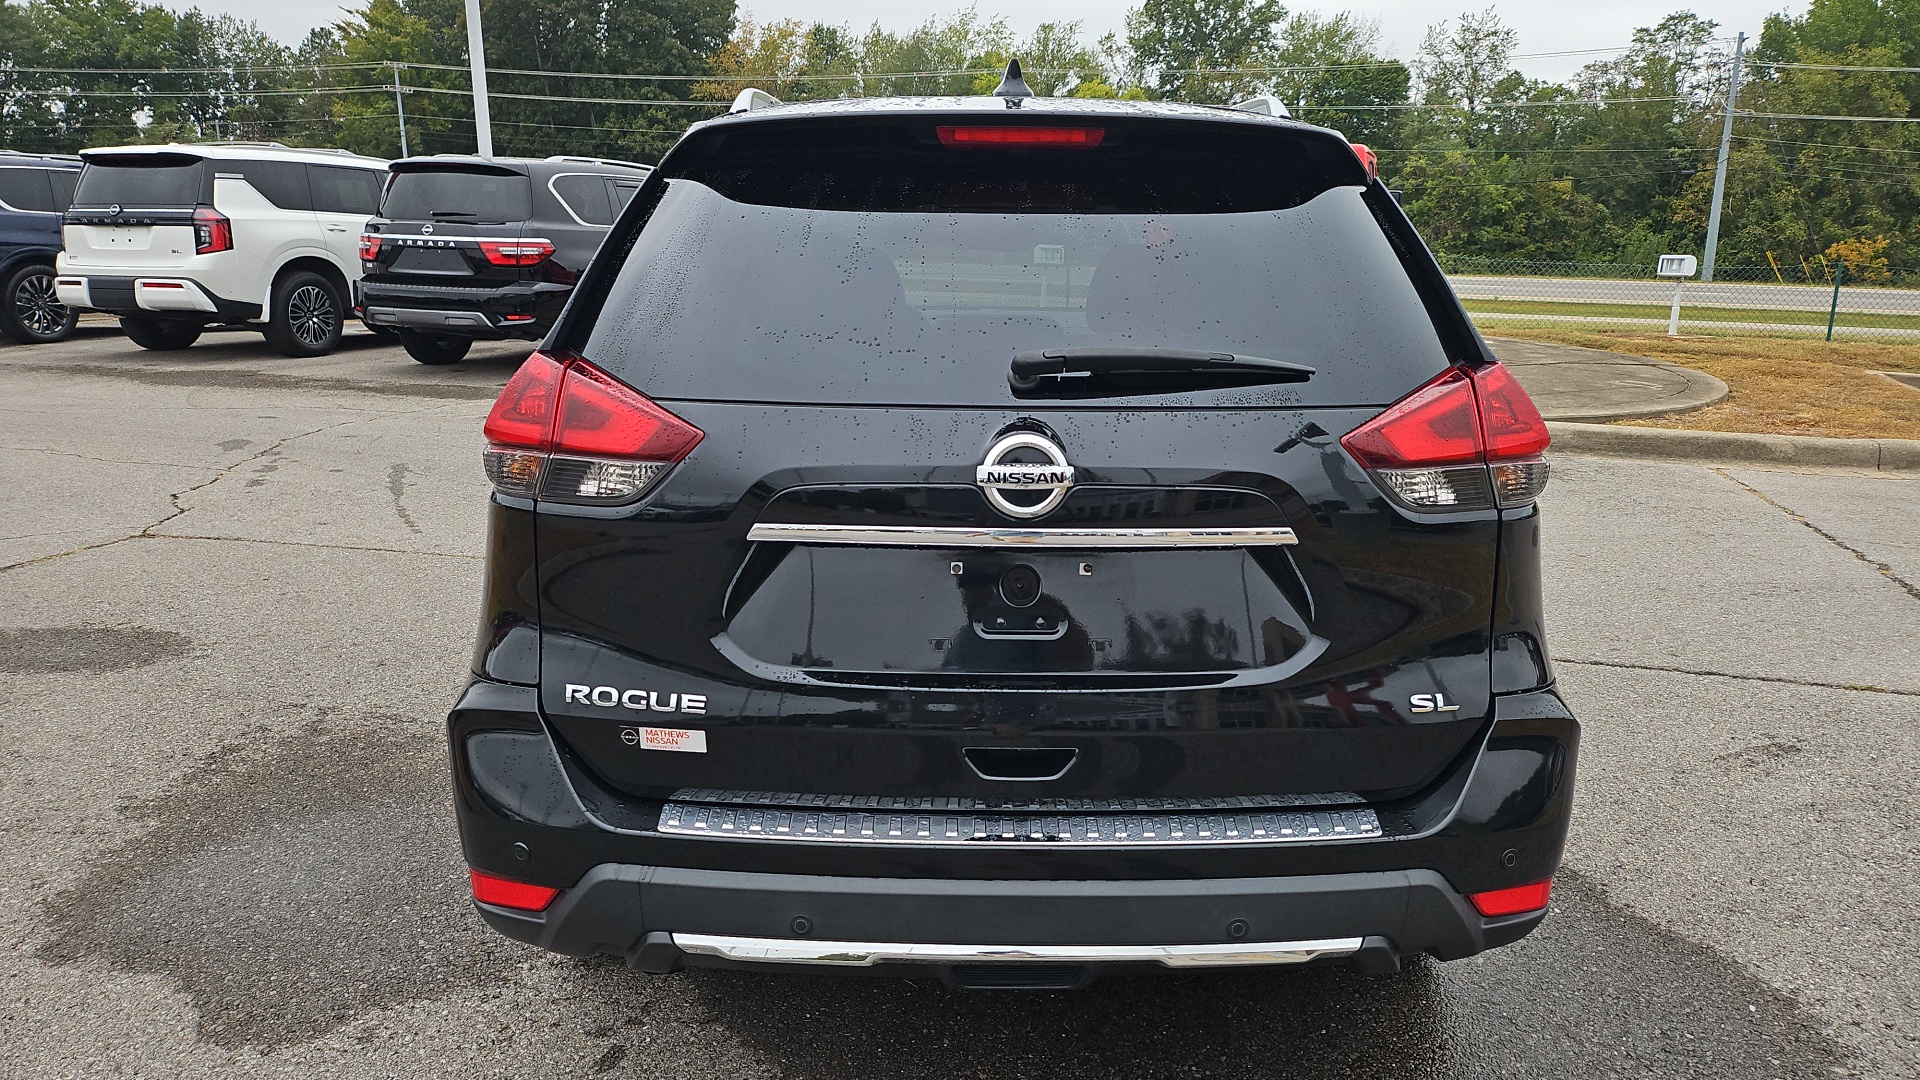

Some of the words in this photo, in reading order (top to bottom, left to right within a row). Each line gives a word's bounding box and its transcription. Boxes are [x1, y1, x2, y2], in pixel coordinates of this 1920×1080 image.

[397, 239, 456, 248] ARMADA
[987, 471, 1064, 484] NISSAN
[565, 683, 707, 715] ROGUE
[1409, 693, 1461, 713] SL
[645, 728, 690, 739] MATHEWS
[646, 736, 679, 745] NISSAN
